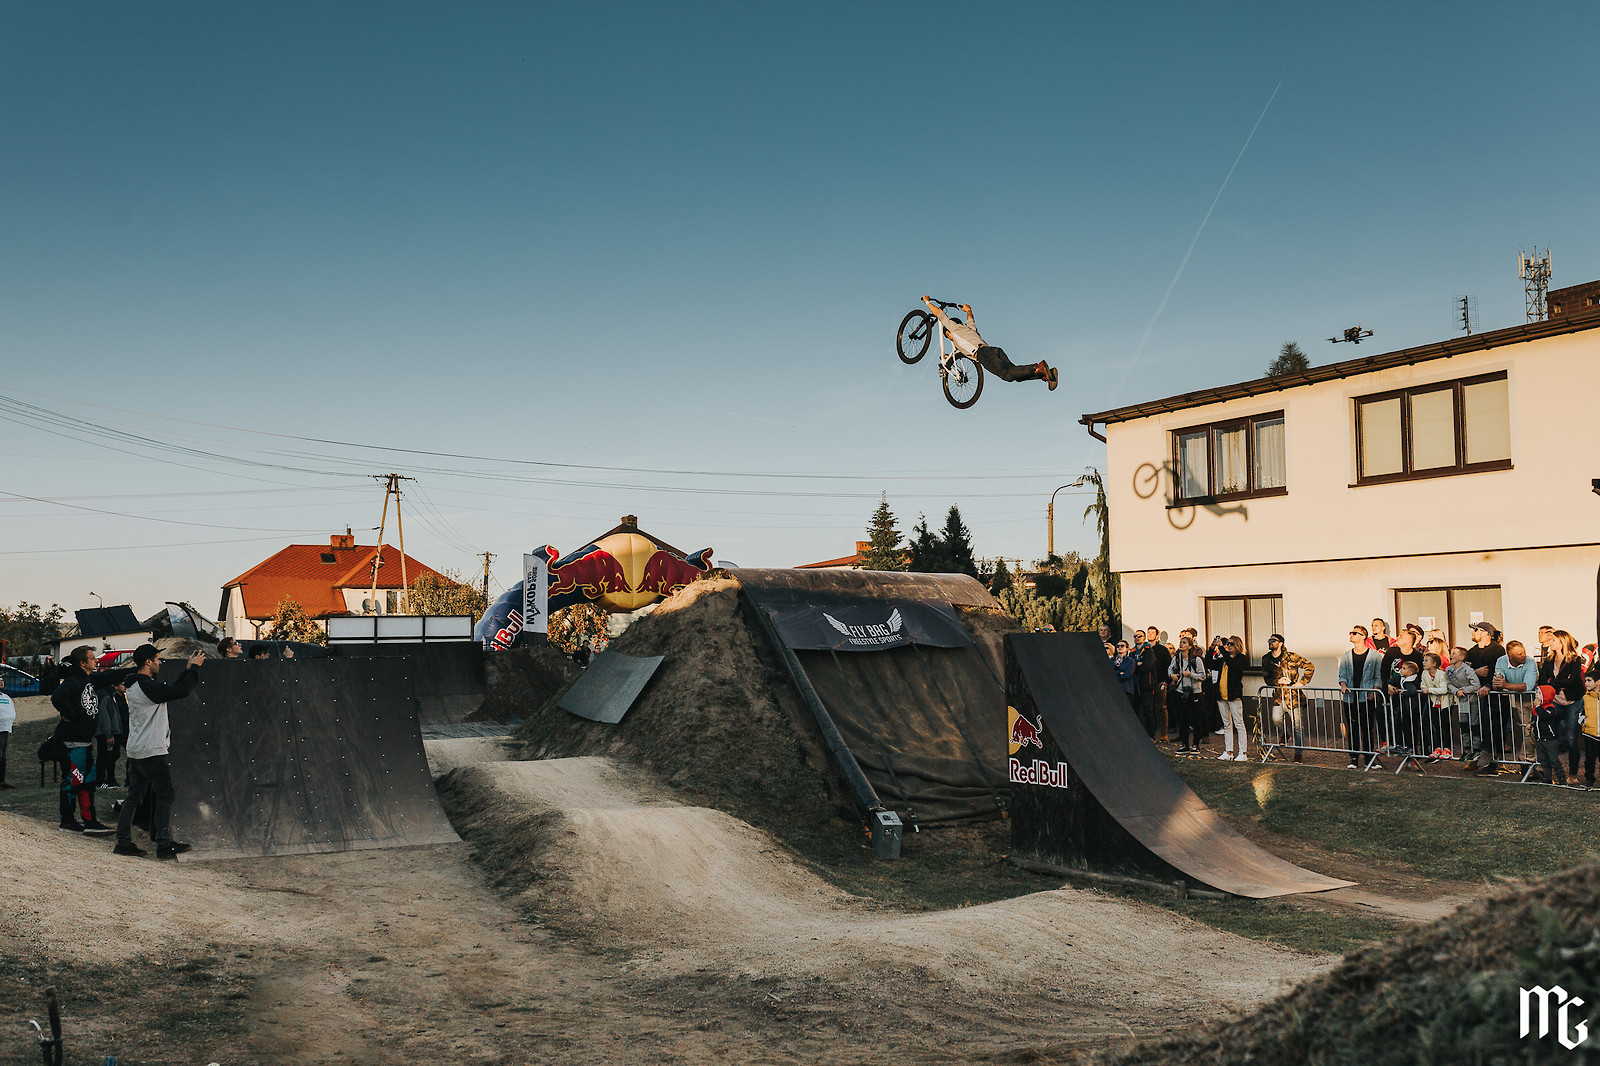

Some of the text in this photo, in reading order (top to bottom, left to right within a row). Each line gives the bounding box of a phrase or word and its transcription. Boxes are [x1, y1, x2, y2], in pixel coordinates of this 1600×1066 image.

[494, 608, 524, 647] Bull
[848, 623, 890, 638] FLY BAG
[848, 633, 903, 645] FREESTYLE SPORTS
